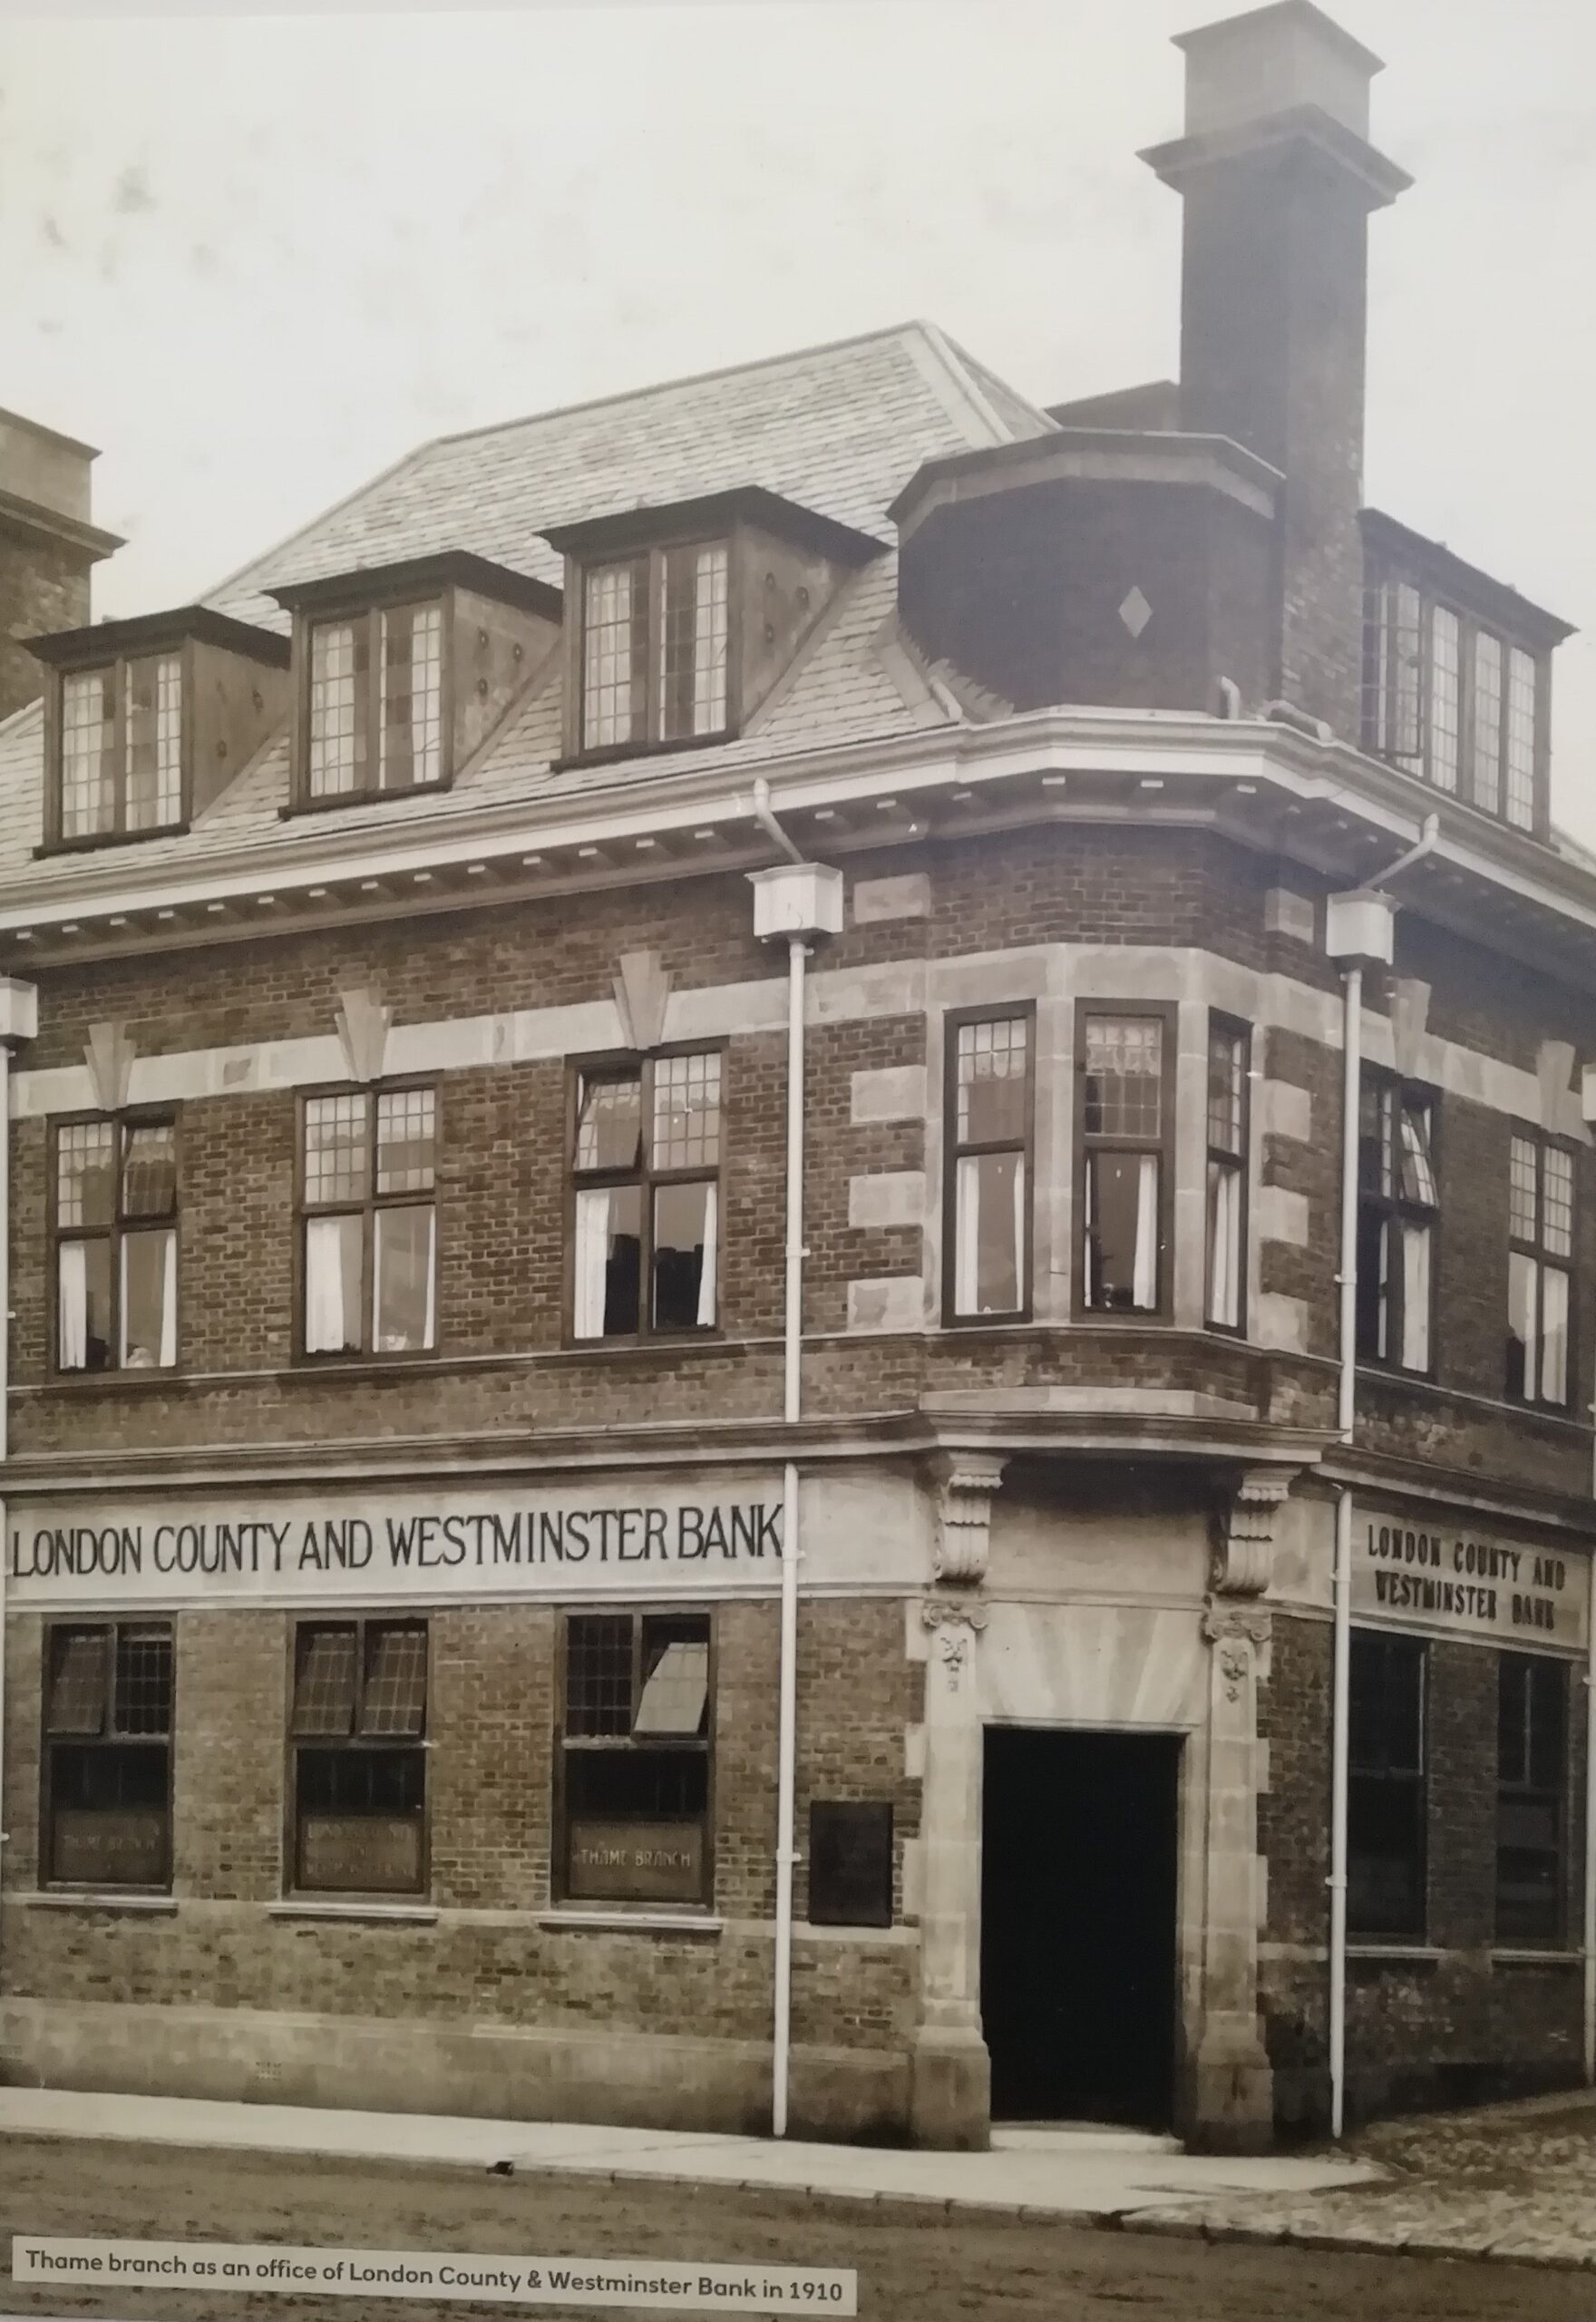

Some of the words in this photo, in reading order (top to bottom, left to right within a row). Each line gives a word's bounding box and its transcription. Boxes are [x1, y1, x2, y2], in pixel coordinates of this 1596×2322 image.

[13, 1526, 142, 1577] LONDON
[153, 1520, 291, 1573] COUNTY
[298, 1518, 374, 1570] AND
[385, 1508, 668, 1566] WESTMINSTER
[678, 1503, 783, 1560] BANK
[1368, 1524, 1441, 1566] LONDON
[1454, 1541, 1522, 1582] COUNTY
[1533, 1556, 1566, 1591] AND
[1375, 1569, 1496, 1620] WESTMINSTER
[1511, 1593, 1554, 1630] BANK
